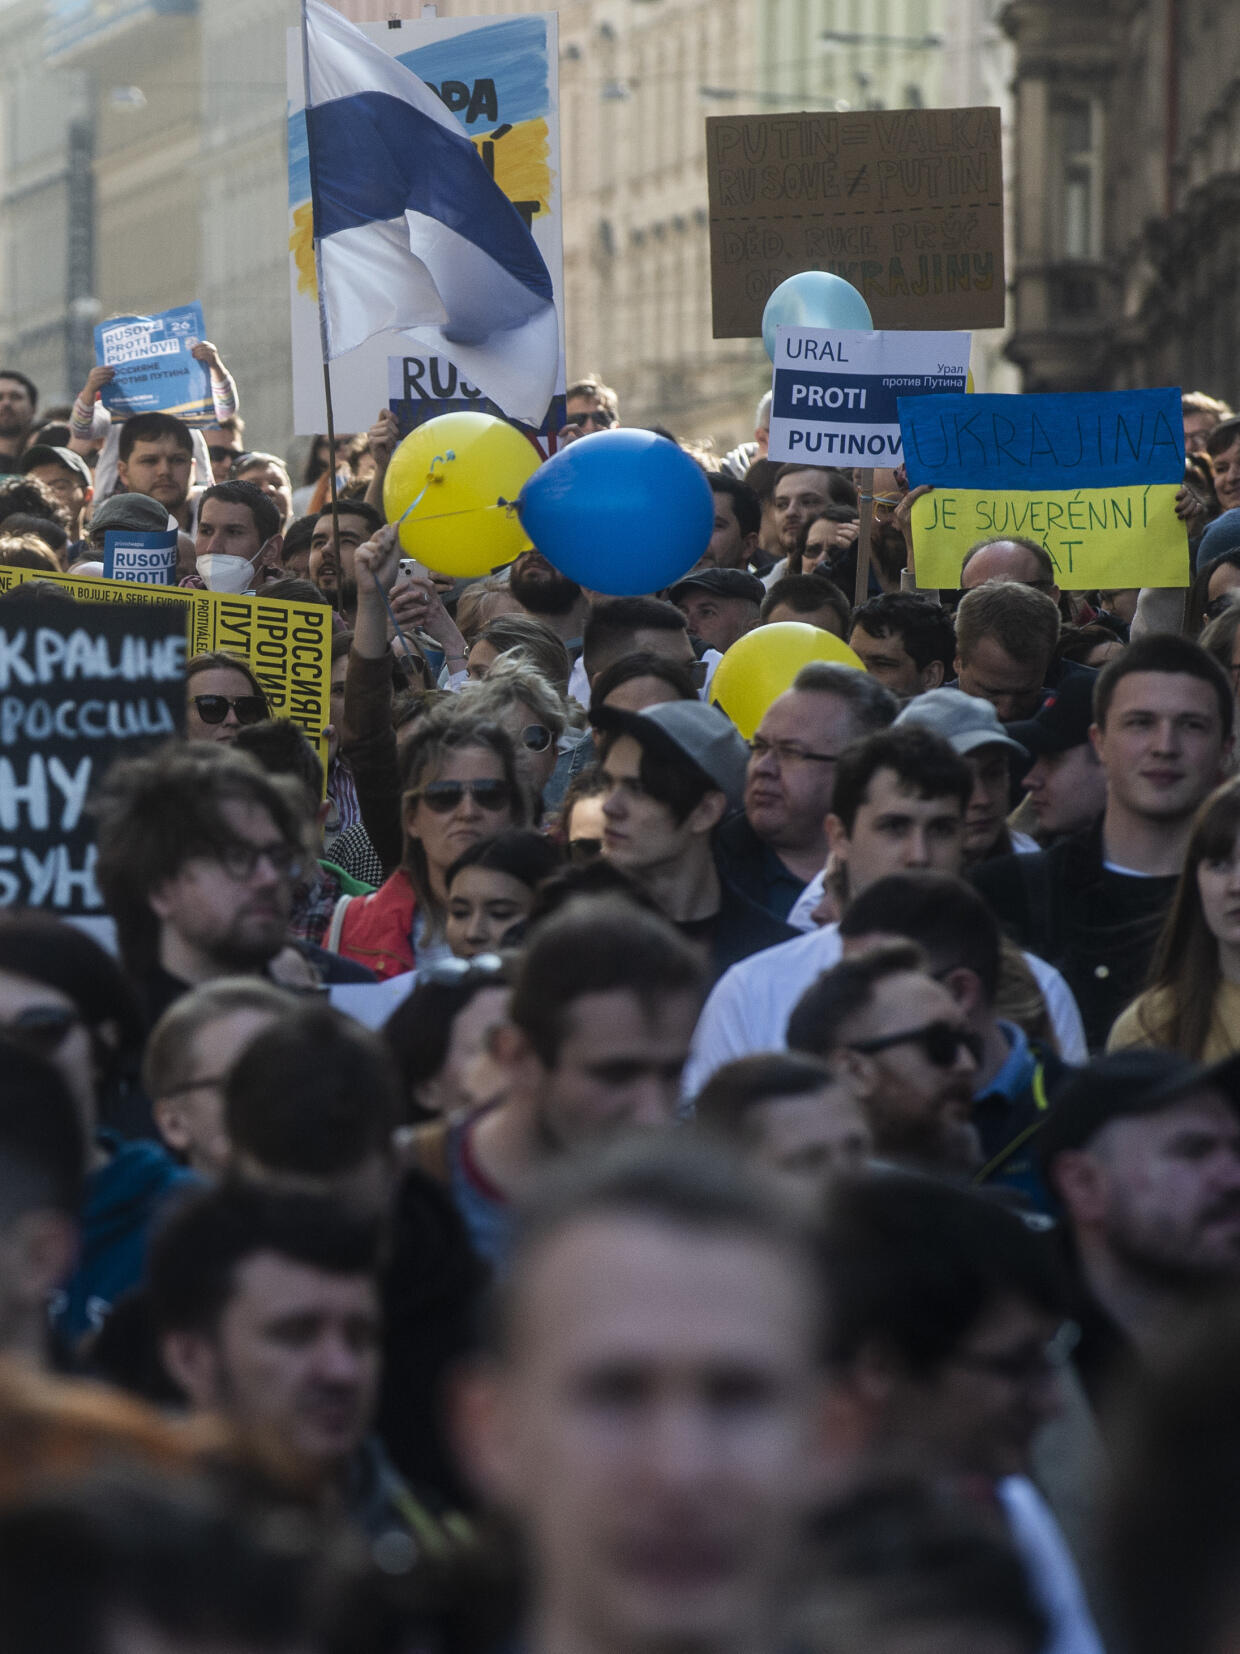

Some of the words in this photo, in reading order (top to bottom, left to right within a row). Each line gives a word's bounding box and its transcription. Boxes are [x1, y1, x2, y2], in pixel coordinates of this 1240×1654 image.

[424, 78, 498, 124] PA
[107, 336, 148, 353] PROTI
[786, 337, 849, 362] URAL
[113, 374, 148, 385] РОТИВ
[114, 362, 160, 375] ОССИЯНЕ
[937, 363, 964, 376] Урал
[882, 377, 921, 388] против
[923, 376, 964, 389] Путина
[792, 384, 867, 410] PROTI
[789, 431, 903, 455] PUTINOV
[911, 410, 1182, 468] UKRAJINA
[925, 498, 956, 530] JE
[976, 484, 1153, 532] SUVERÉNNÍ
[78, 587, 110, 601] BOJUJE
[0, 697, 176, 745] РОССИИ
